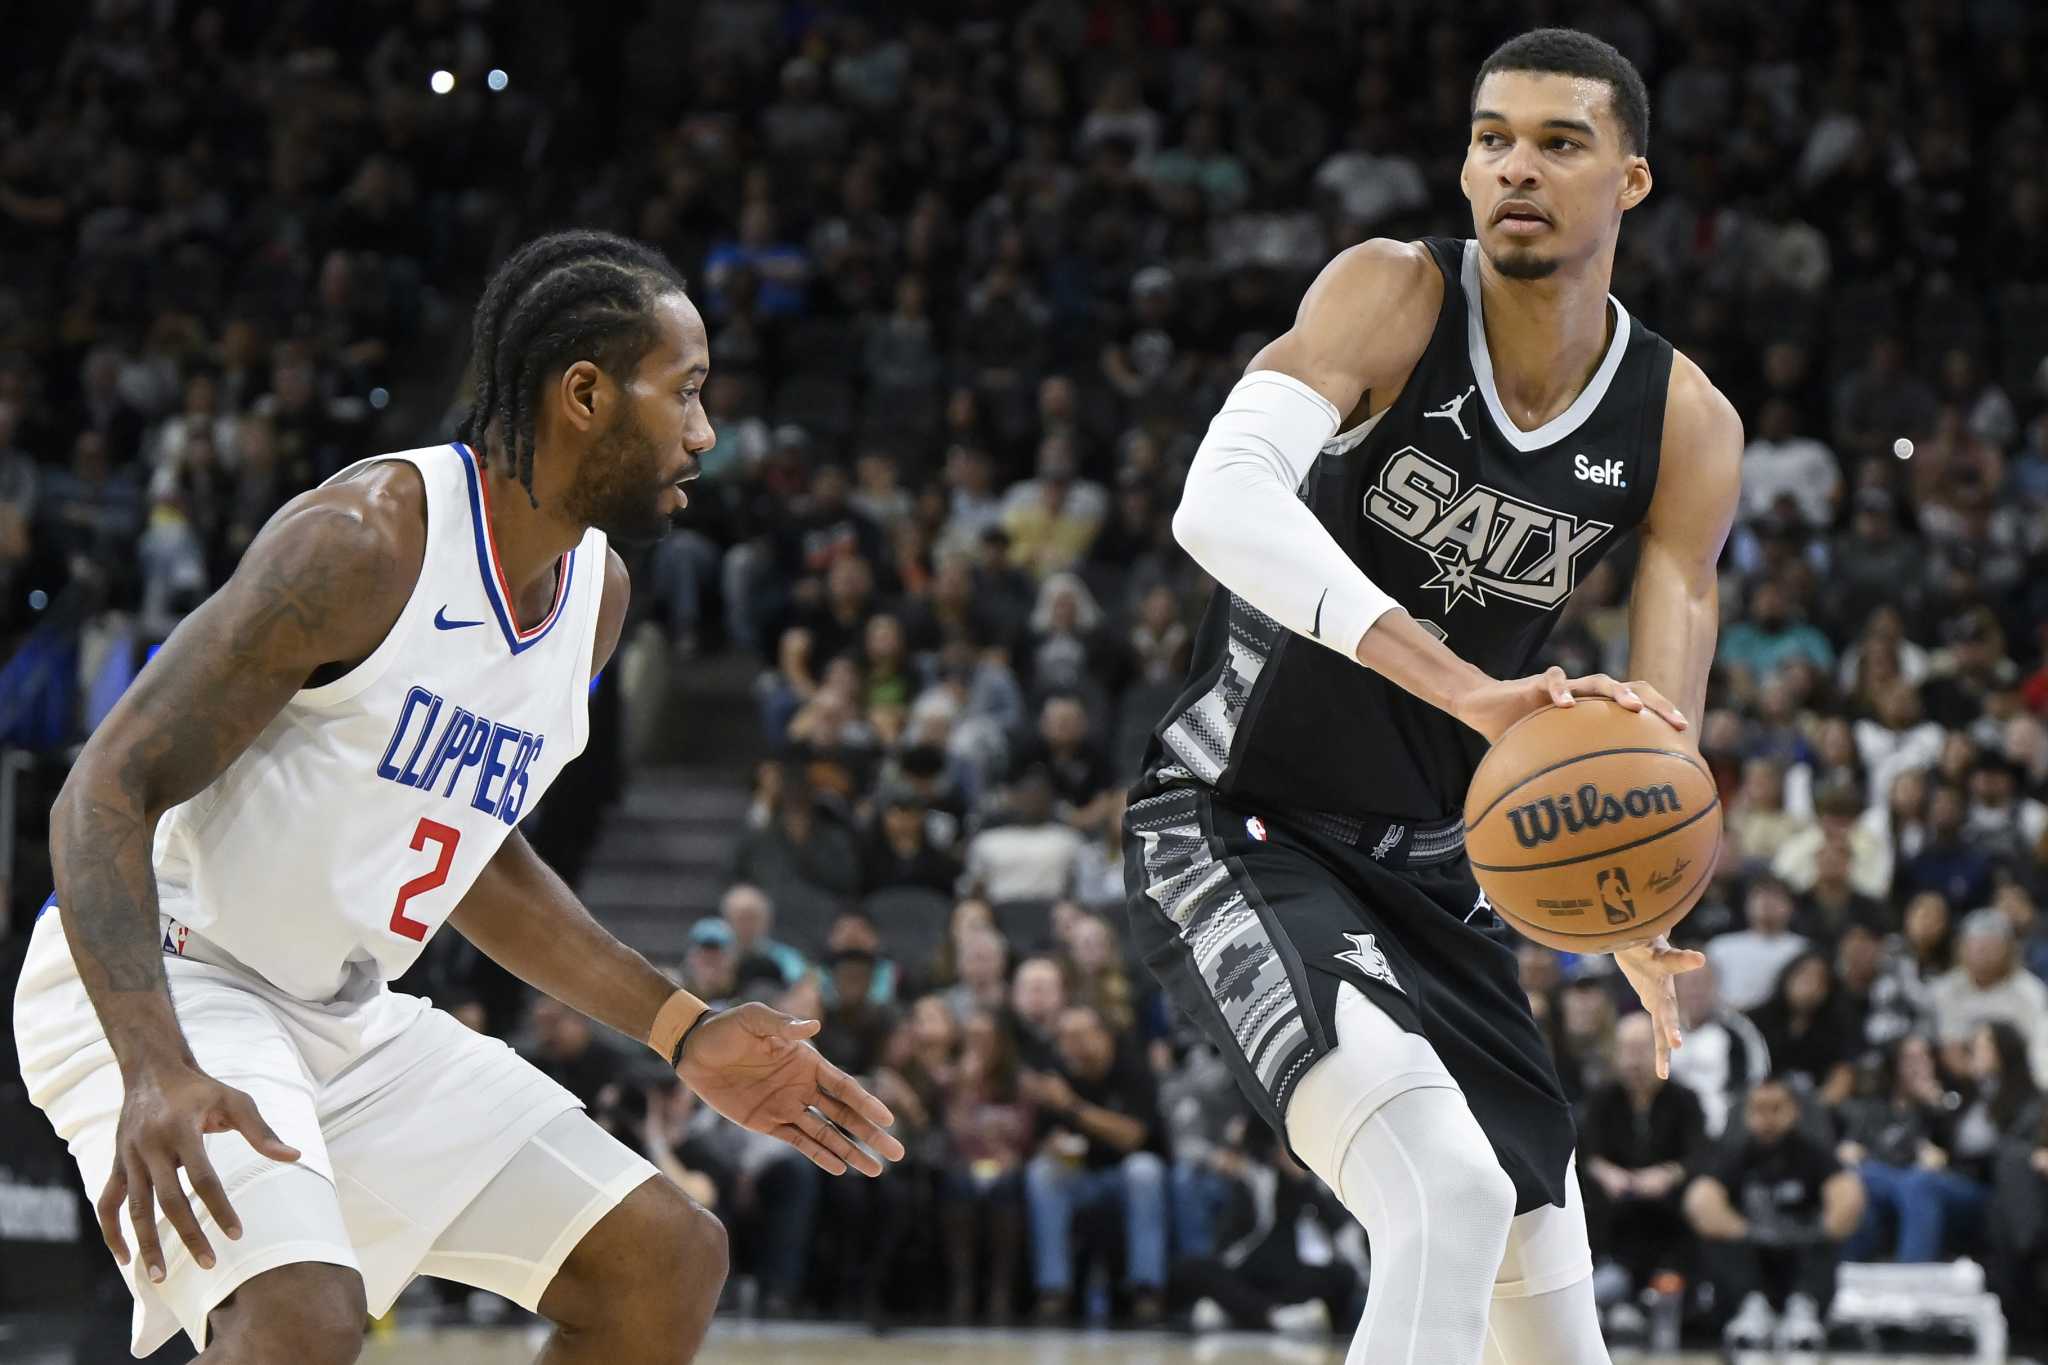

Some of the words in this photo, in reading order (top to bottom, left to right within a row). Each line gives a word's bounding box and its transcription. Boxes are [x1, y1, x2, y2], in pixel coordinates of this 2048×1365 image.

[1364, 446, 1614, 610] SATX
[1574, 454, 1627, 488] Self.
[377, 686, 544, 826] CLIPPERS
[1506, 782, 1681, 848] Wilson
[389, 816, 461, 942] 2
